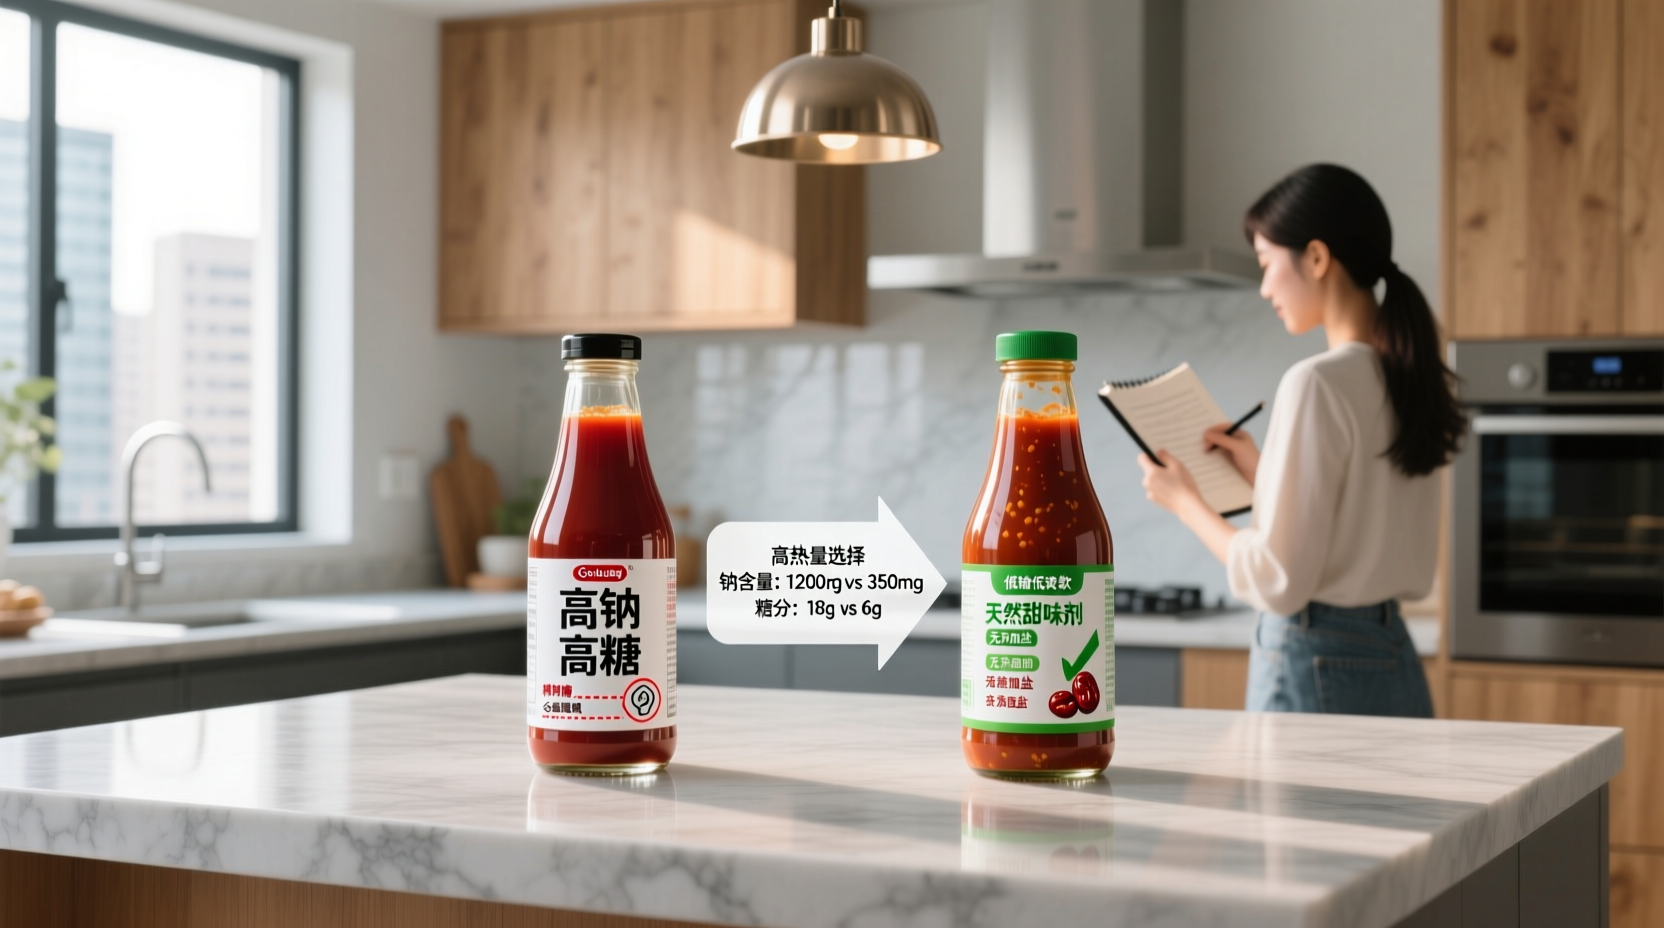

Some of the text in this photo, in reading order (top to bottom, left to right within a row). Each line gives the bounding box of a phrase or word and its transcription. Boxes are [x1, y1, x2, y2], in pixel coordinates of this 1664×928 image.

[559, 587, 640, 630] 高钠
[985, 601, 1083, 626] 天然甜味剂
[559, 634, 641, 677] 高糖
